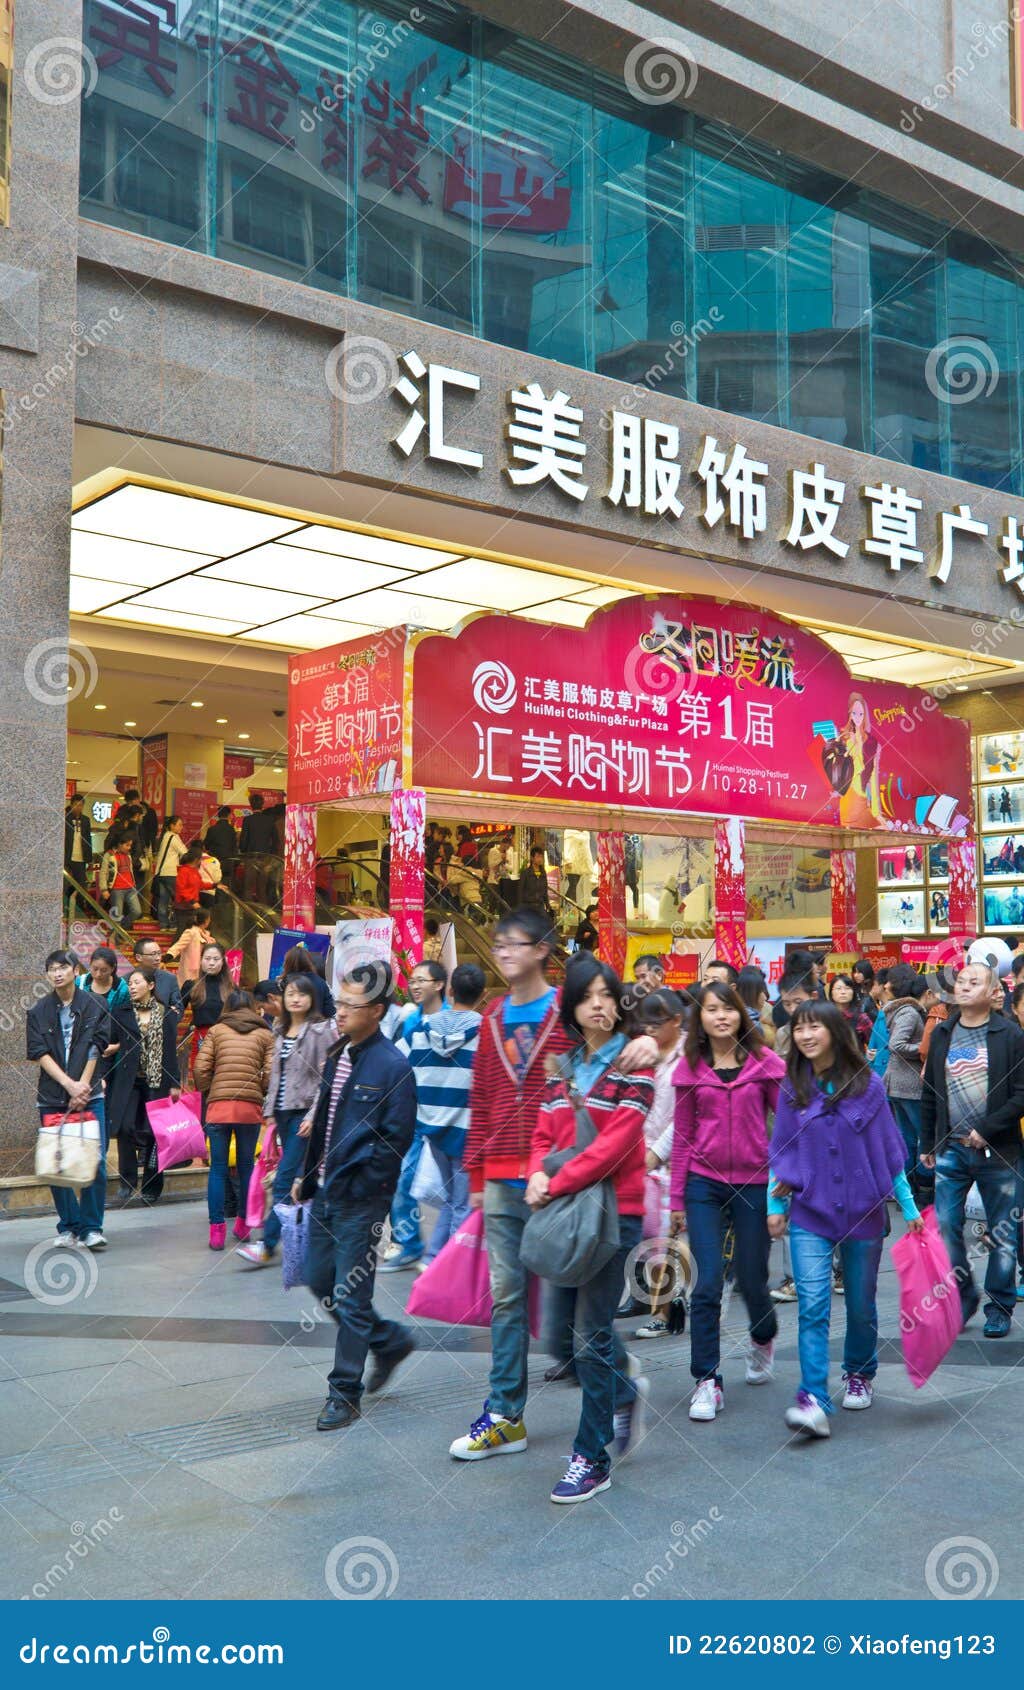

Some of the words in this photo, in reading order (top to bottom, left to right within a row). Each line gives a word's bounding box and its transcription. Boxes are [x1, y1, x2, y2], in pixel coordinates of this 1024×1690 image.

[638, 617, 805, 694] 冬日暖流
[324, 676, 369, 711] 第1届
[524, 676, 668, 717] 汇美服饰皮草广场
[294, 702, 401, 758] 汇美购物节
[524, 702, 565, 718] HuiMei
[641, 717, 669, 732] Plaza
[676, 690, 774, 748] 第1届
[294, 757, 322, 771] Huimei
[323, 748, 365, 765] Shoppig
[472, 721, 693, 798] 汇美购物节
[713, 763, 735, 773] Huimei
[735, 766, 766, 778] Shopping
[713, 774, 807, 800] 10.28-11.27
